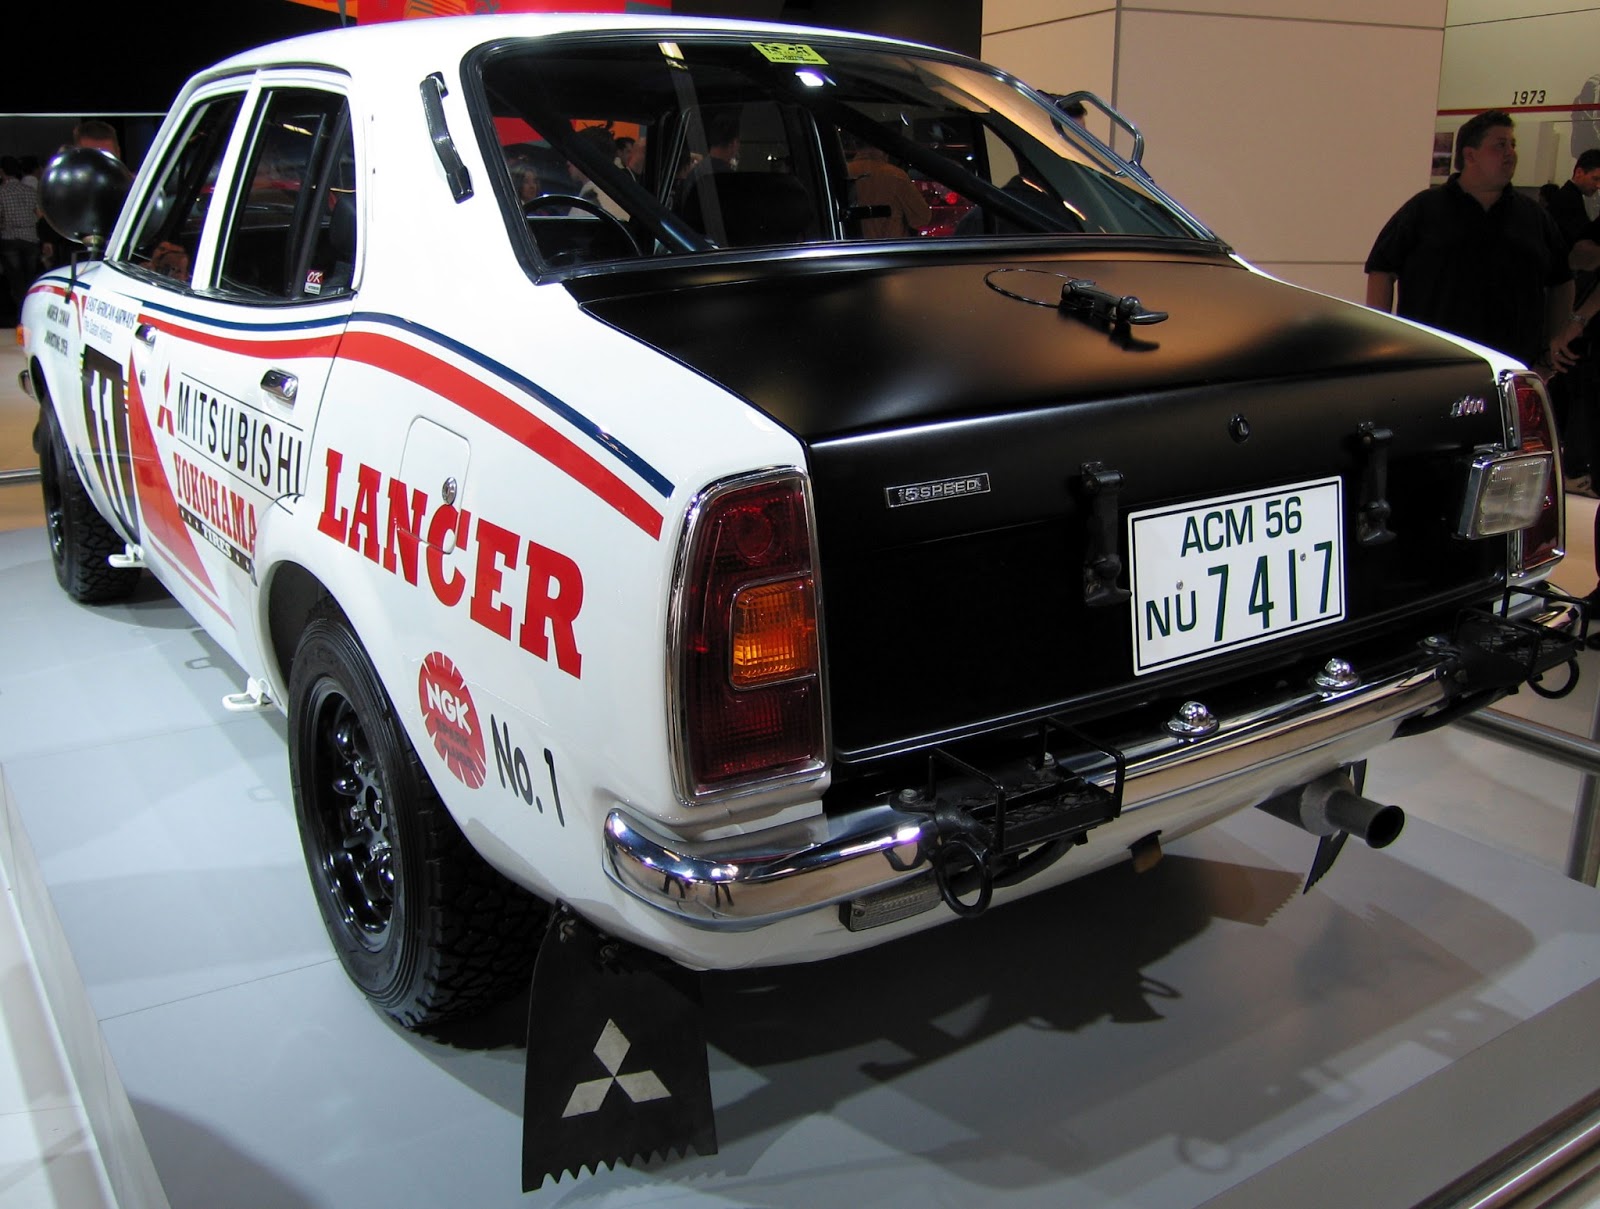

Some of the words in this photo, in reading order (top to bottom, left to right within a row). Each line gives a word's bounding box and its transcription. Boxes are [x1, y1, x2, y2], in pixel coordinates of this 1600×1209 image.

[1512, 90, 1546, 105] 1973
[307, 271, 323, 283] OK
[91, 370, 135, 529] 11
[177, 381, 303, 503] MITSUBISHI
[173, 452, 257, 560] YOKOHAMA
[201, 523, 233, 558] TIRES
[1180, 504, 1254, 557] ACM
[1265, 496, 1303, 539] 56
[317, 447, 584, 680] LANCER
[1146, 590, 1197, 641] NU
[1207, 540, 1333, 643] 7417
[425, 677, 473, 735] NGK
[491, 713, 543, 814] No.
[544, 747, 565, 828] 1
